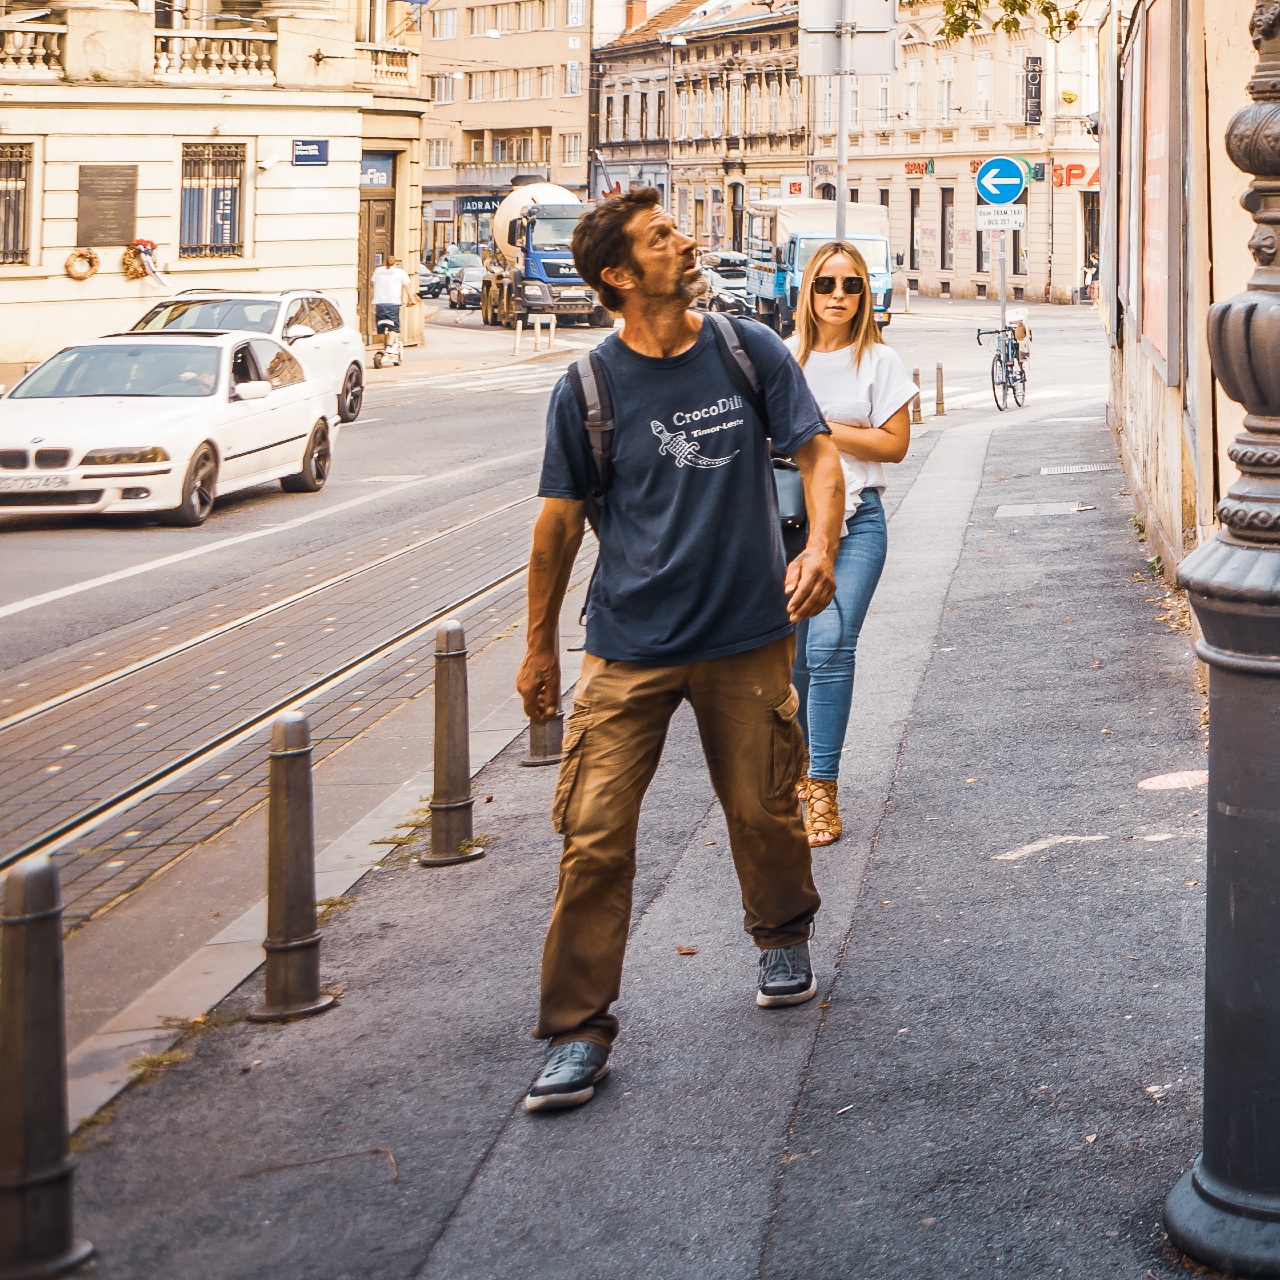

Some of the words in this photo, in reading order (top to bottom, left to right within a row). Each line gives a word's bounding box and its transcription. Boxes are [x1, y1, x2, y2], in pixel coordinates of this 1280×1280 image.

[1027, 58, 1042, 124] HOTEL
[904, 161, 927, 175] SPAR
[462, 200, 499, 211] JADRAN
[672, 395, 743, 426] CrocoDili
[691, 419, 744, 438] Timor-Leste
